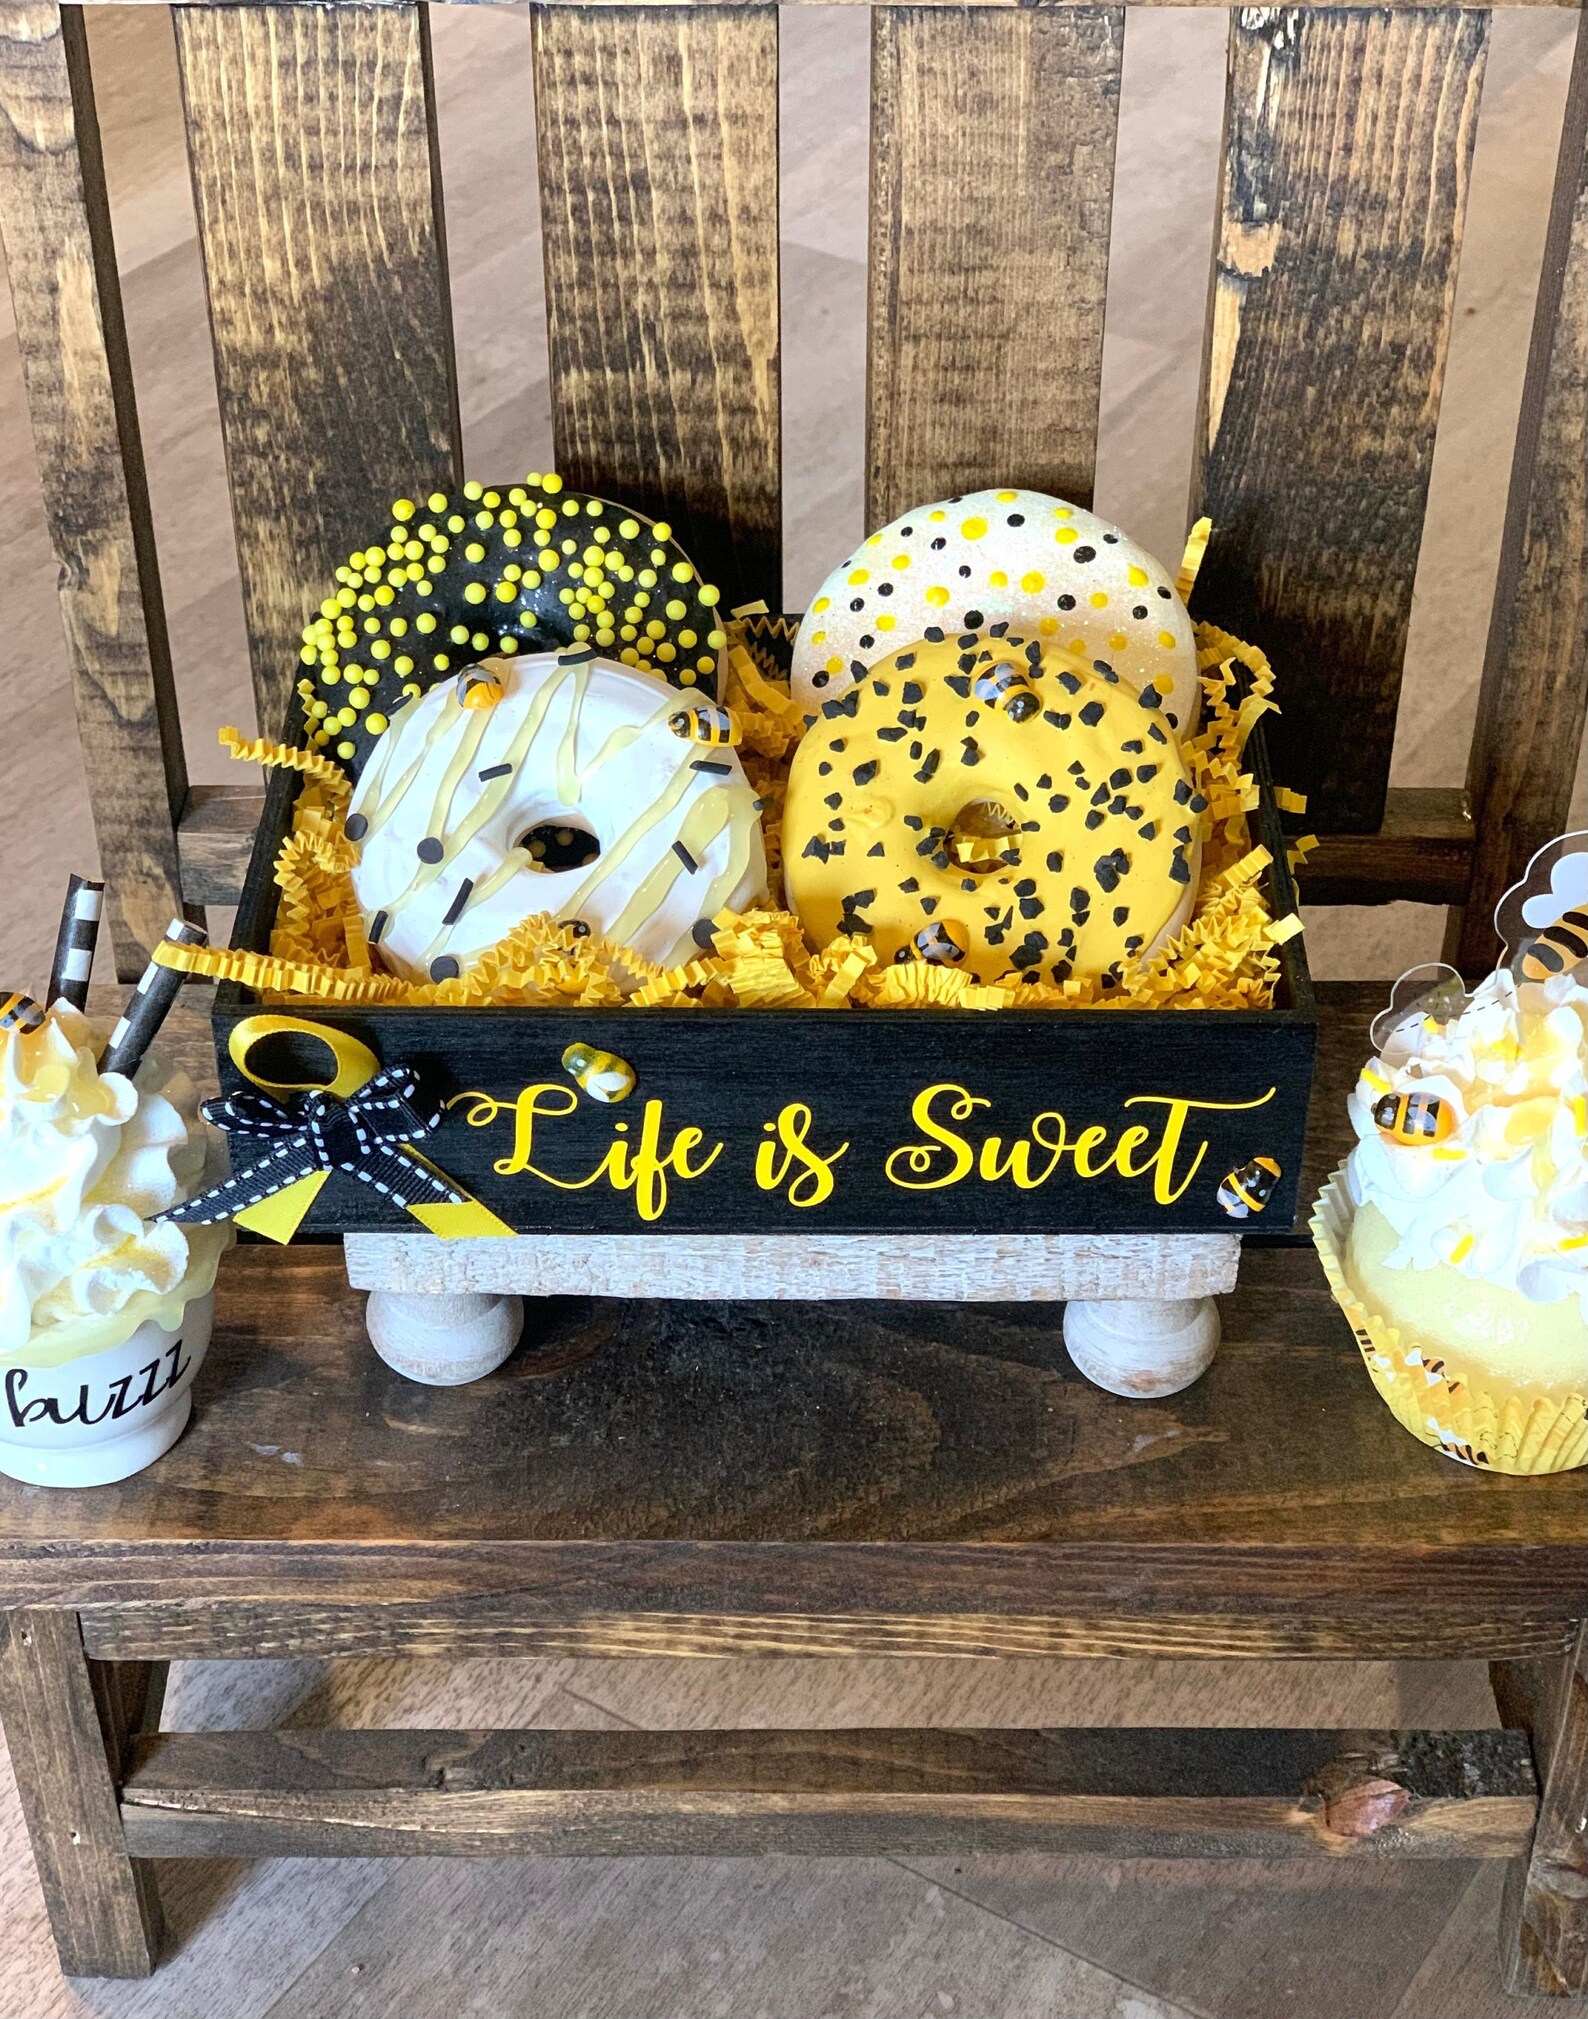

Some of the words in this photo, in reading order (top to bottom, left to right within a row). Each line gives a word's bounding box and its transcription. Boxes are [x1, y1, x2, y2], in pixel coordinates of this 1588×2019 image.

[447, 1084, 724, 1221] Life
[756, 1103, 849, 1207] is
[885, 1084, 1277, 1206] Sweet
[5, 1338, 192, 1427] buzzz
